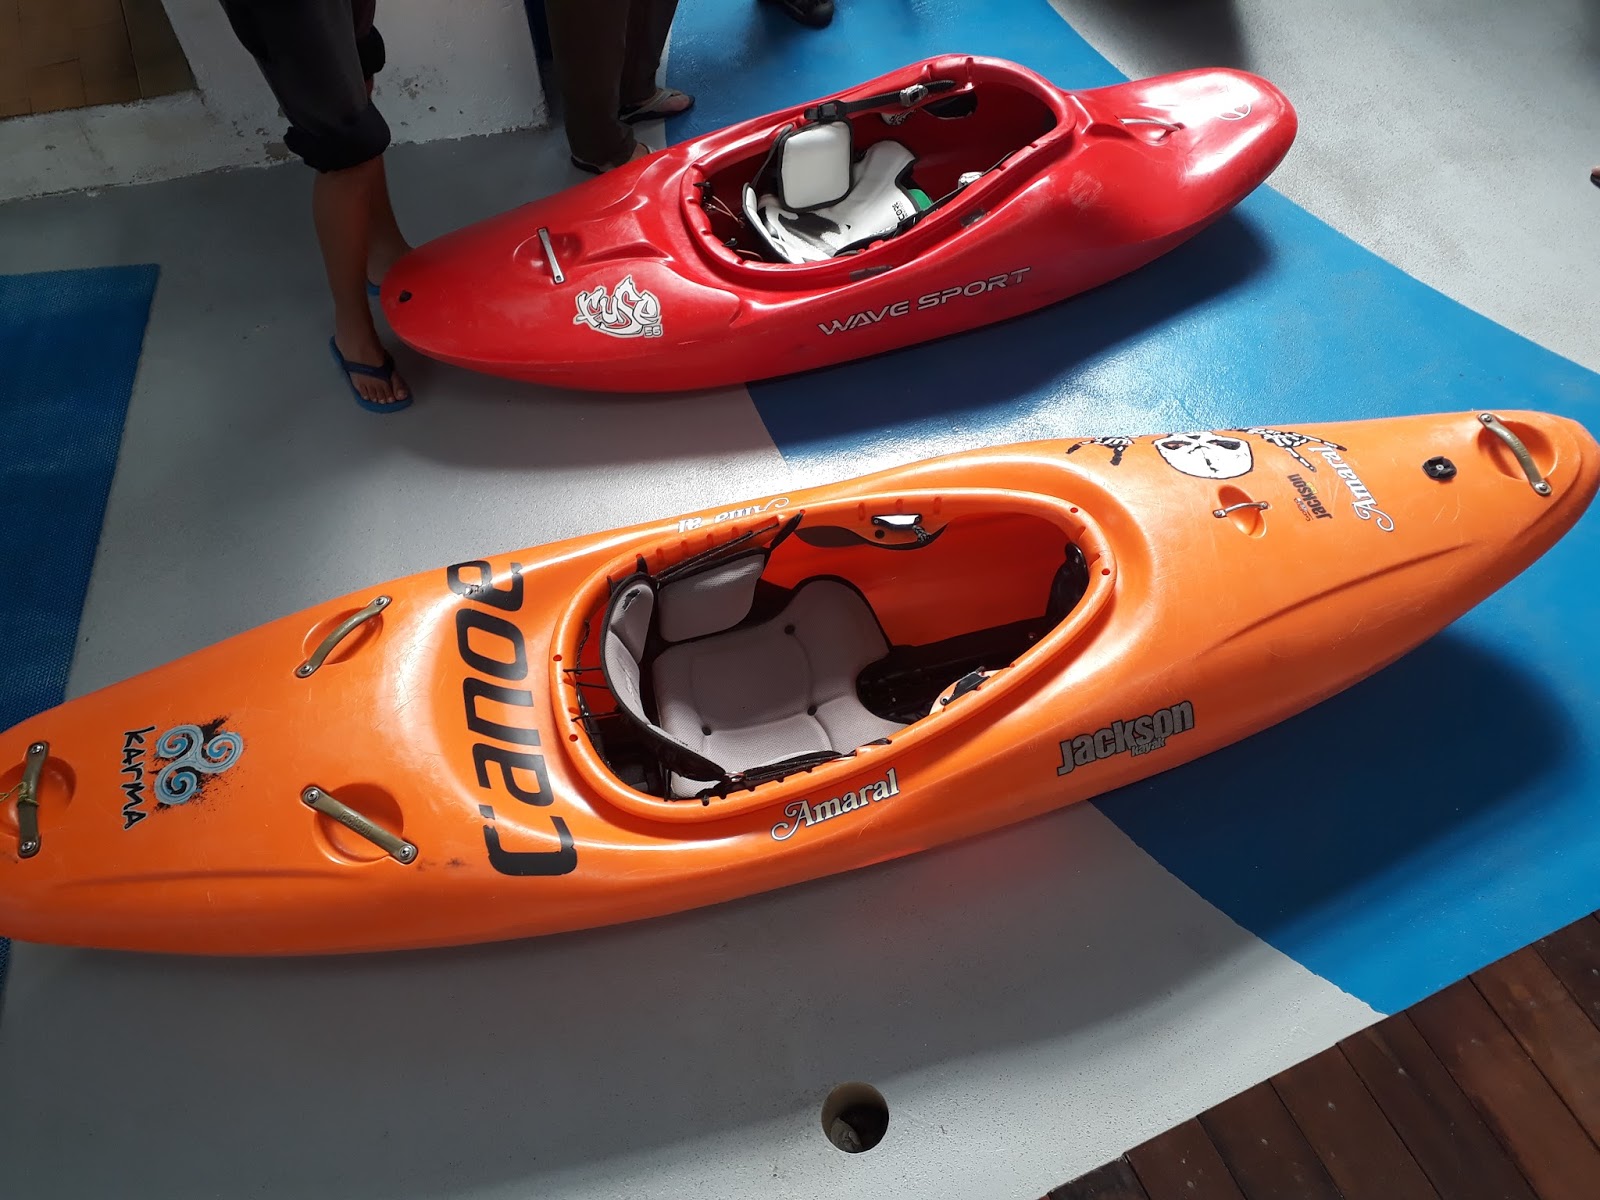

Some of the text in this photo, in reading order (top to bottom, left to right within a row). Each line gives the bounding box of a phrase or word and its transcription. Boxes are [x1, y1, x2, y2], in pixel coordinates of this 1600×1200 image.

[817, 267, 1031, 336] WAVE SPORT
[1287, 473, 1333, 520] Jackson
[1307, 445, 1394, 533] Amaral
[446, 560, 578, 876] Canoe
[1056, 700, 1195, 776] Jackson
[770, 767, 900, 841] Amaral
